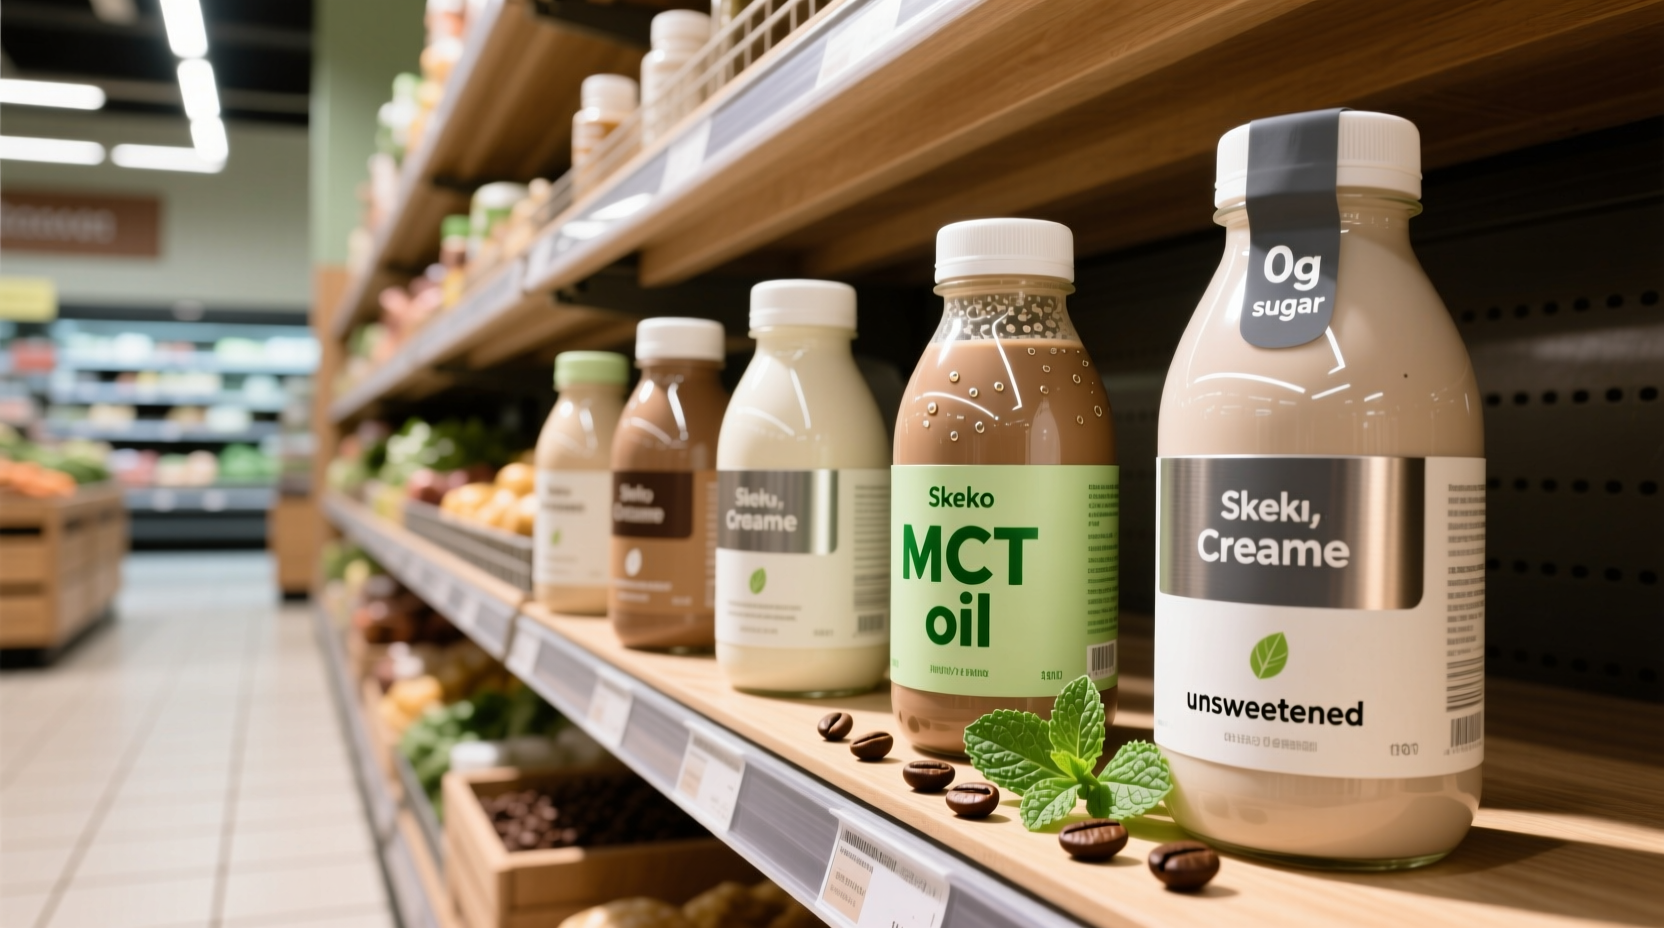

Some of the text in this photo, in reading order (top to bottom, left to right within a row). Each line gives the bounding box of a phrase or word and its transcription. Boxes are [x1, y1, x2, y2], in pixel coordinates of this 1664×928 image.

[1263, 244, 1321, 291] 0g
[1252, 295, 1325, 321] sugar
[928, 485, 995, 509] Skeko
[902, 523, 1039, 586] MCT
[1197, 528, 1350, 568] Creame
[925, 591, 990, 648] oil
[1186, 691, 1364, 726] unsweetened
